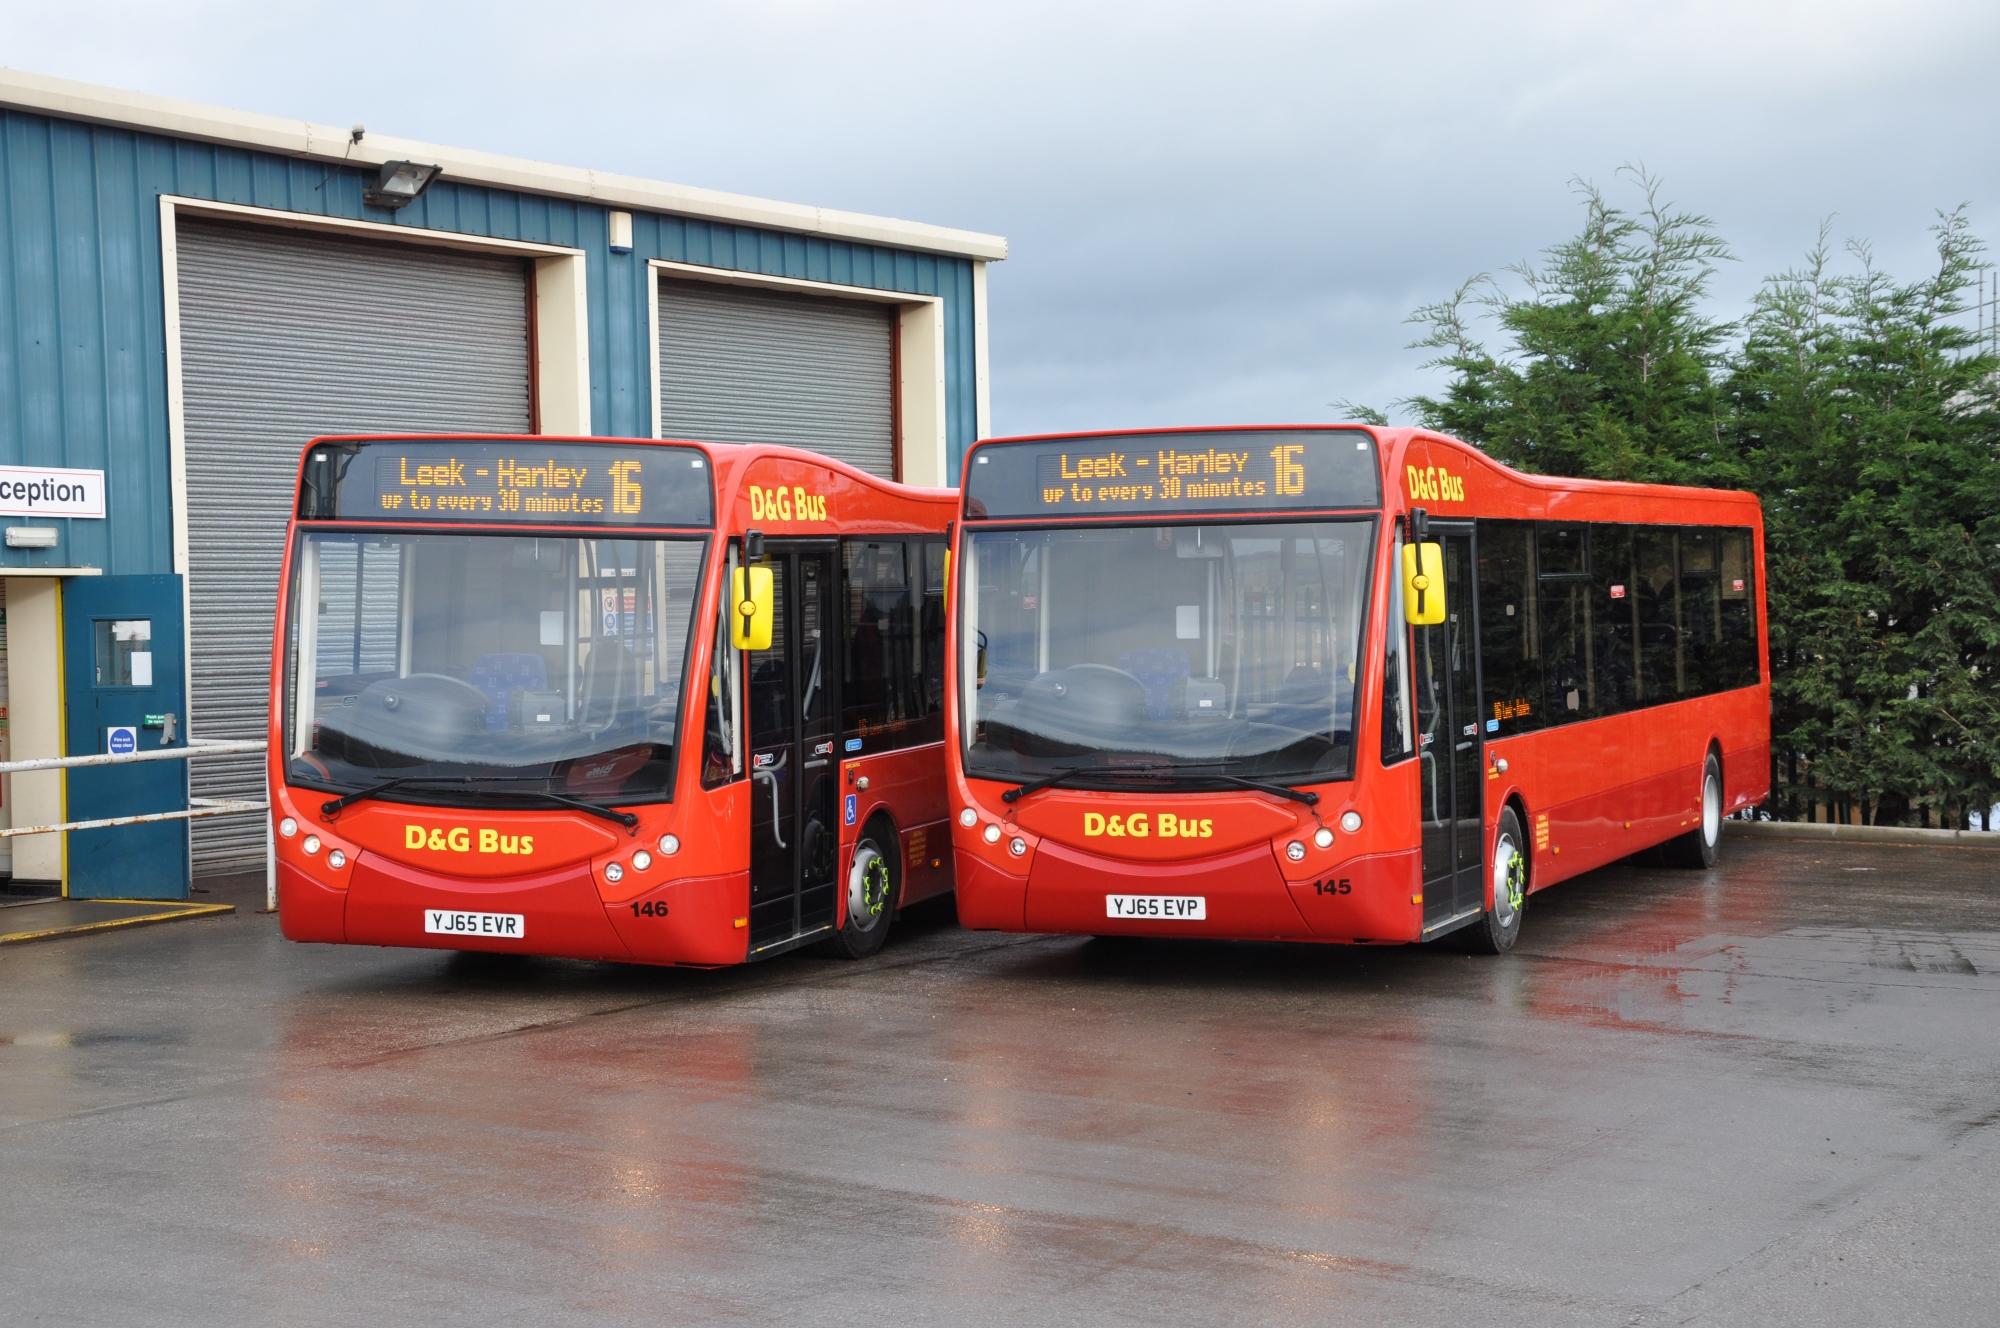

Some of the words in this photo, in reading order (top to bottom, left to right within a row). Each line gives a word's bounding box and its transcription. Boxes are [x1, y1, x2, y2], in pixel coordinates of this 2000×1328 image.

[400, 457, 466, 487] Leek
[498, 459, 587, 489] Hanley
[1062, 452, 1127, 479] Leek
[1158, 449, 1249, 480] Hanley
[1270, 445, 1305, 495] 16
[609, 460, 642, 514] 16
[1043, 487, 1065, 503] up
[1071, 483, 1092, 502] to
[1097, 482, 1153, 501] every
[1158, 477, 1181, 499] 30
[1186, 478, 1266, 499] minutes
[1406, 465, 1439, 501] D&G
[1438, 467, 1465, 502] Bus
[382, 494, 404, 510] up
[410, 490, 431, 510] to
[436, 494, 492, 512] every
[498, 488, 520, 511] 30
[526, 493, 604, 513] minutes
[749, 485, 792, 521] D&G
[793, 487, 827, 521] Bus
[1084, 813, 1149, 837] D&G
[1158, 813, 1213, 838] Bus
[405, 825, 470, 853] D&G
[479, 829, 534, 855] Bus
[1313, 879, 1353, 895] 145
[630, 901, 668, 917] 146
[1114, 898, 1159, 916] YJ65
[1164, 899, 1198, 916] EVP
[433, 914, 477, 933] YJ65
[482, 916, 516, 934] EVR
